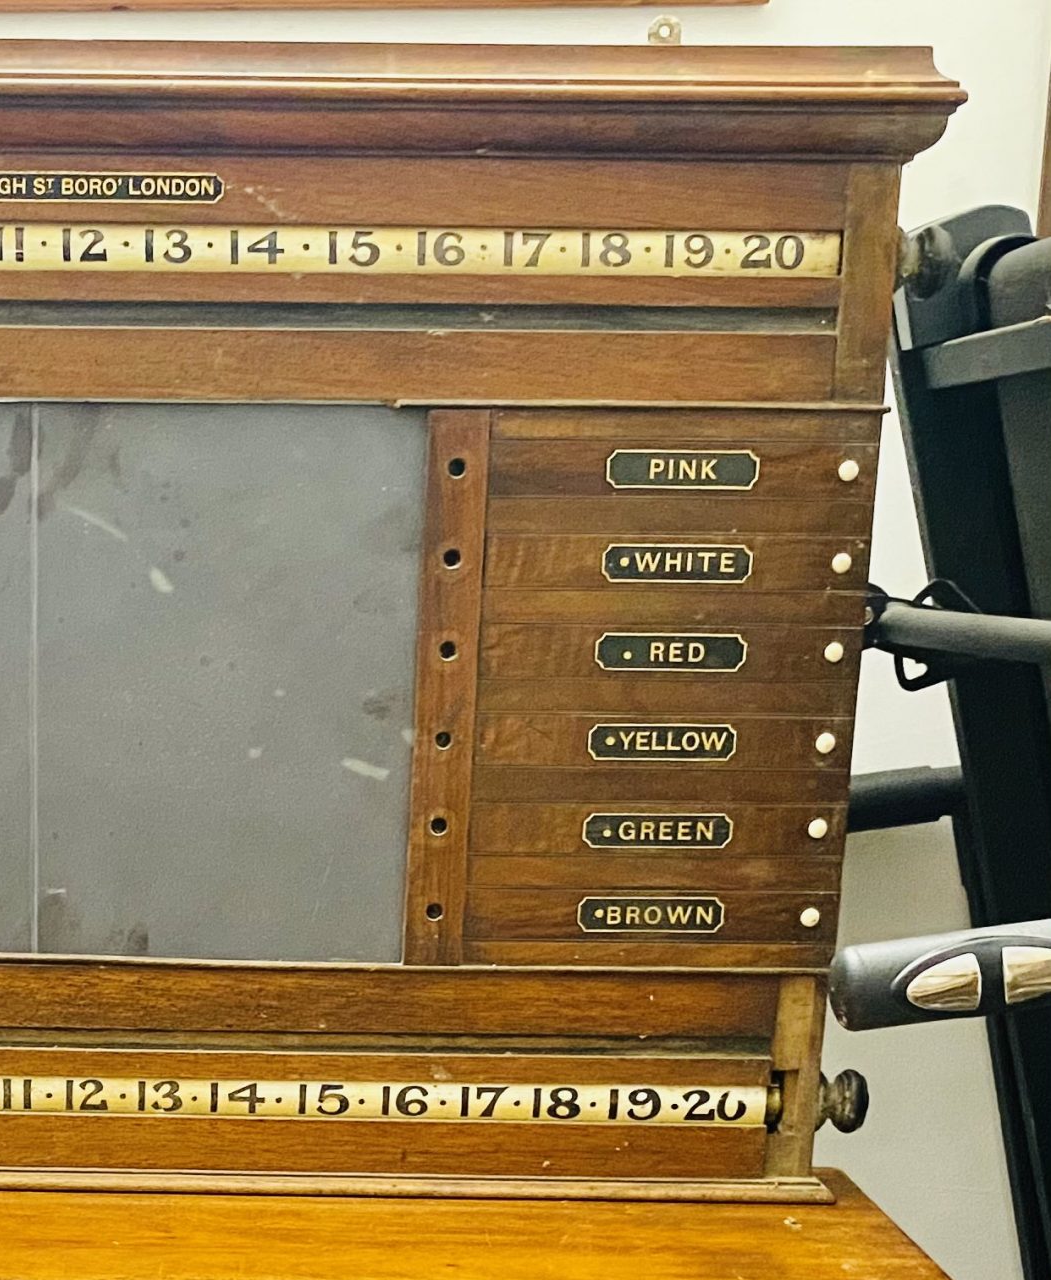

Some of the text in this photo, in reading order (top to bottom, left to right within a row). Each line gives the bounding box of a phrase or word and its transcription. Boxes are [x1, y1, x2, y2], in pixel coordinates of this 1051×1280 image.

[128, 178, 214, 196] LONDON
[62, 228, 108, 262] 12
[145, 229, 192, 264] 13
[230, 230, 285, 265] 14
[328, 230, 380, 266] 15
[417, 231, 465, 266] 16
[503, 231, 552, 267] 17
[581, 232, 632, 268] 18
[664, 233, 714, 268] 19
[740, 234, 805, 270] 20
[649, 459, 718, 480] PINK
[65, 1079, 109, 1111] 12
[137, 1081, 183, 1112] 13
[210, 1082, 266, 1113] 14
[299, 1084, 350, 1115] 15
[382, 1085, 429, 1117] 16
[460, 1086, 509, 1118] 17
[532, 1087, 581, 1119] 18
[608, 1088, 662, 1121] 19
